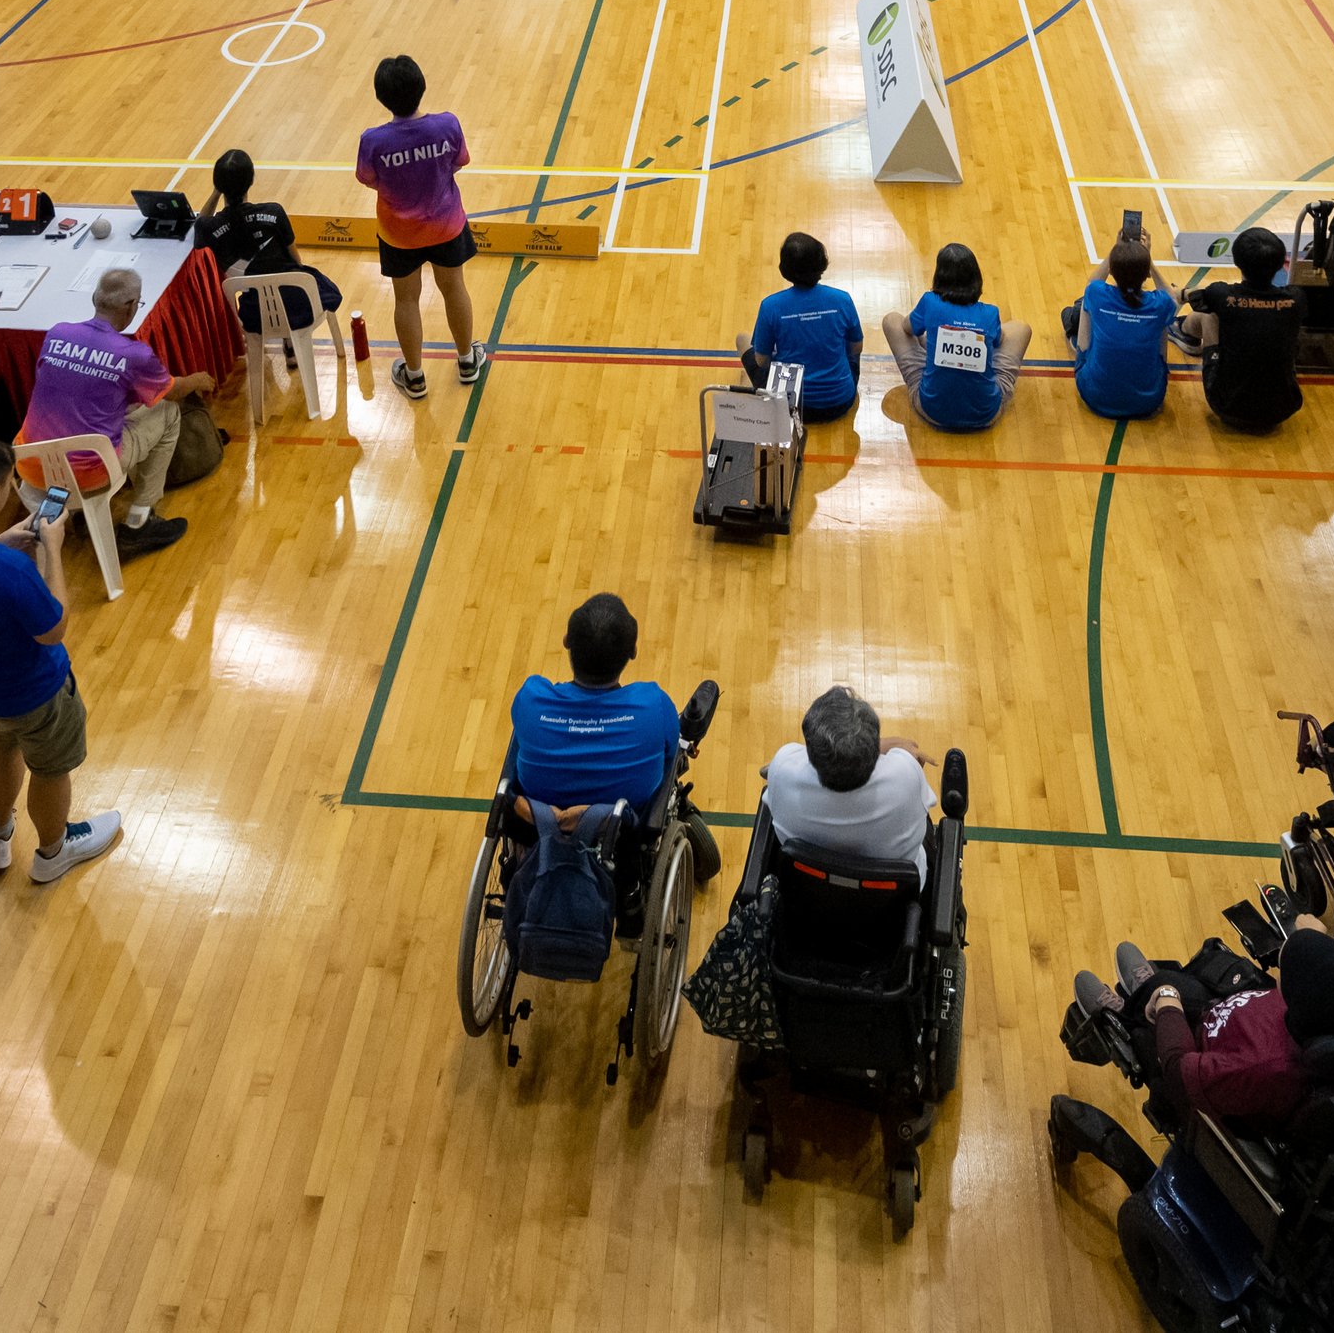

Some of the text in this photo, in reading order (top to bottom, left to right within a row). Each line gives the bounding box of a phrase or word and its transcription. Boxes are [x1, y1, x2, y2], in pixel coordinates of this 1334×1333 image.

[877, 38, 897, 102] SDSC
[380, 140, 451, 168] YO! NILA
[2, 197, 11, 211] 2
[19, 192, 31, 217] 1
[48, 339, 127, 372] TEAM NILA
[942, 342, 981, 358] M308
[44, 356, 120, 383] SPORT VOLUNTEER
